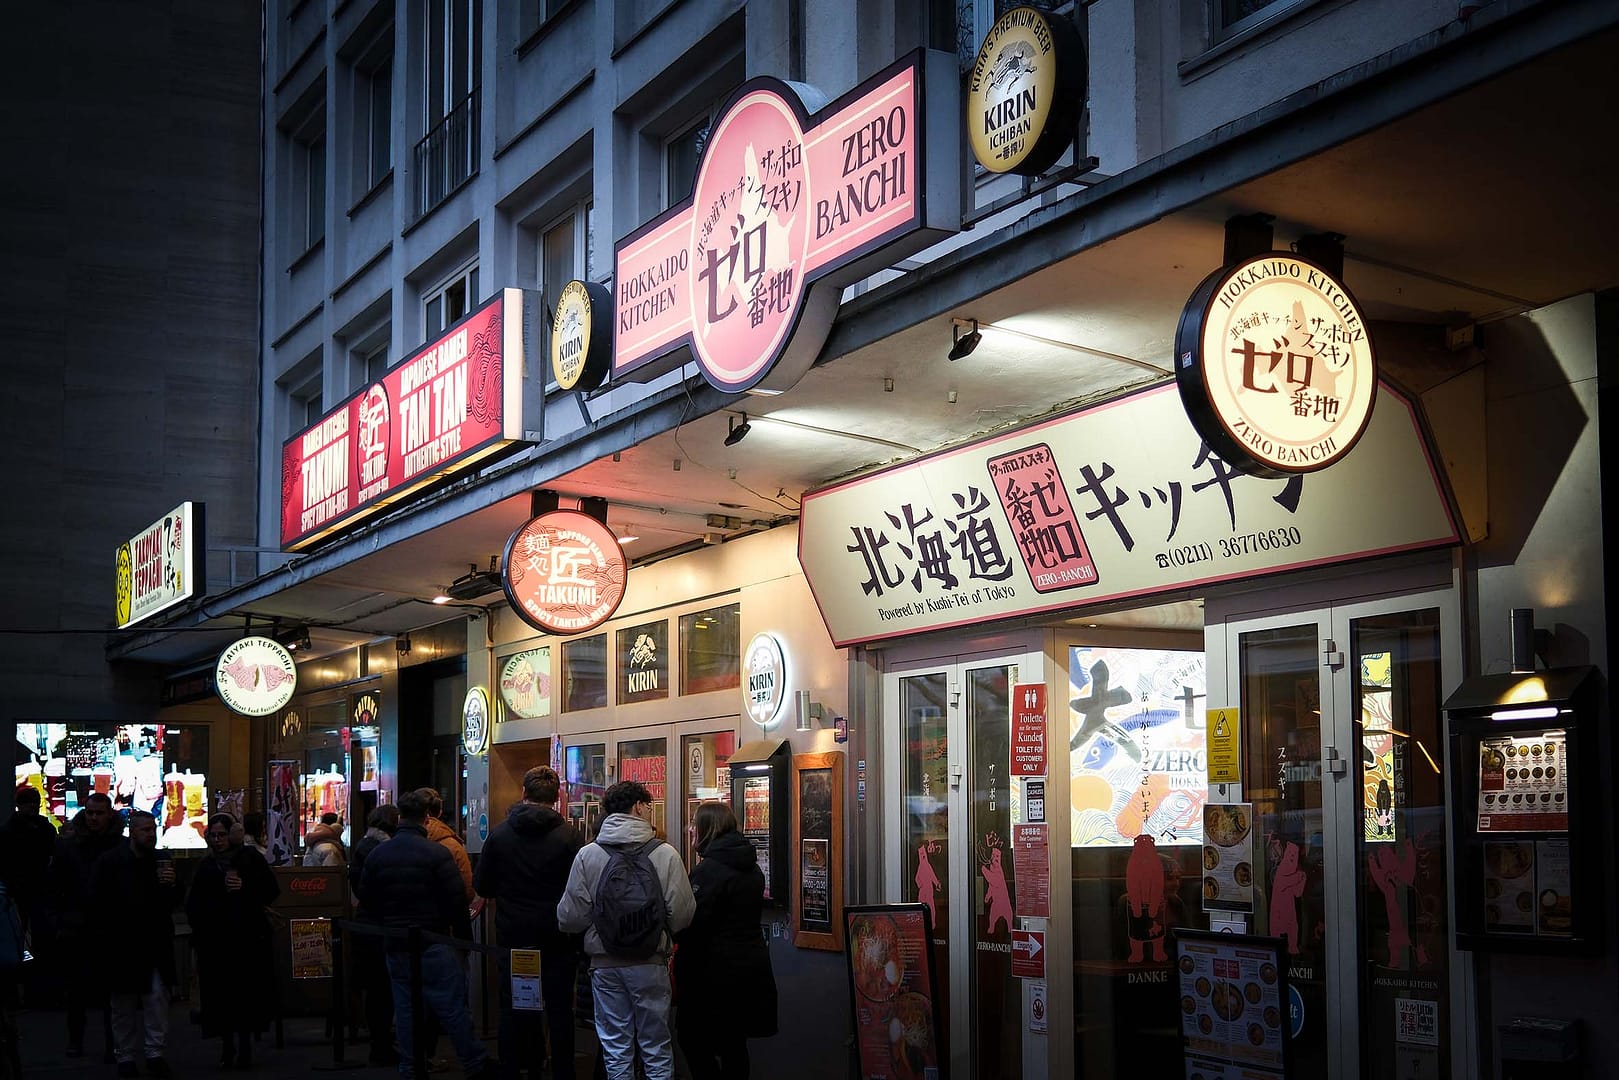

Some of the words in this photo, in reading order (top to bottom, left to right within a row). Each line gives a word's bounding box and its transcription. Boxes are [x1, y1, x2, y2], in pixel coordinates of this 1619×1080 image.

[971, 39, 993, 92] KIRIN'S
[994, 10, 1035, 41] PREMIUM
[1033, 17, 1051, 56] BEER
[984, 85, 1036, 135] KIRIN
[842, 105, 906, 178] ZERO
[990, 117, 1031, 150] ICHIBAN
[761, 139, 802, 180] サッポロ
[754, 180, 801, 217] ススキノ
[816, 150, 906, 240] BANCHI
[621, 248, 688, 306] HOKKAIDO
[698, 213, 767, 324] ゼロ
[620, 283, 677, 335] KITCHEN
[747, 268, 794, 329] 番地
[1219, 261, 1301, 309] HOKKAIDO
[1307, 269, 1365, 342] KITCHEN
[1229, 311, 1305, 341] 北海道キッチン
[1310, 317, 1352, 344] サッポロ
[400, 348, 437, 398] JAPANESE
[437, 328, 468, 373] RAMEN
[559, 334, 583, 362] KIRIN
[1231, 335, 1314, 394] ゼロ
[1302, 332, 1351, 367] ススキノ
[399, 384, 430, 457] TAN
[433, 361, 468, 437] TAN
[1290, 385, 1340, 423] 番地
[403, 438, 441, 480] AUTHENTIC
[440, 425, 462, 460] STYLE
[1232, 417, 1273, 455] ZERO
[1277, 436, 1337, 463] BANCHI
[301, 435, 349, 511] TAKUMI
[990, 449, 1050, 477] サッポロススキノ
[135, 525, 163, 572] TAKOYAKI
[846, 485, 1013, 599] 北海道
[1167, 540, 1213, 568] (0211)
[1219, 525, 1302, 558] 36776630
[134, 555, 163, 600] TEPPACHI
[547, 546, 597, 586] 匠
[525, 598, 553, 622] SPICY
[877, 602, 914, 621] Powered
[913, 601, 925, 615] by
[925, 592, 970, 613] Kushi-Tei
[971, 589, 982, 604] of
[982, 585, 1016, 601] Tokyo
[223, 640, 254, 665] TAIYAKI
[257, 639, 292, 671] TEPPACHI
[628, 669, 658, 693] KIRIN
[749, 671, 774, 692] KIRIN
[1017, 732, 1044, 743] Kunden
[1018, 712, 1044, 724] Toilette
[622, 757, 666, 782] JAPANESE
[1015, 746, 1034, 754] TOILET
[1034, 745, 1043, 753] FOR
[1022, 763, 1038, 771] ONLY
[1140, 691, 1151, 824] ありがとうございます
[988, 763, 996, 812] サッポロ
[288, 877, 327, 895] Coca-Cola
[1128, 971, 1168, 984] DANKE
